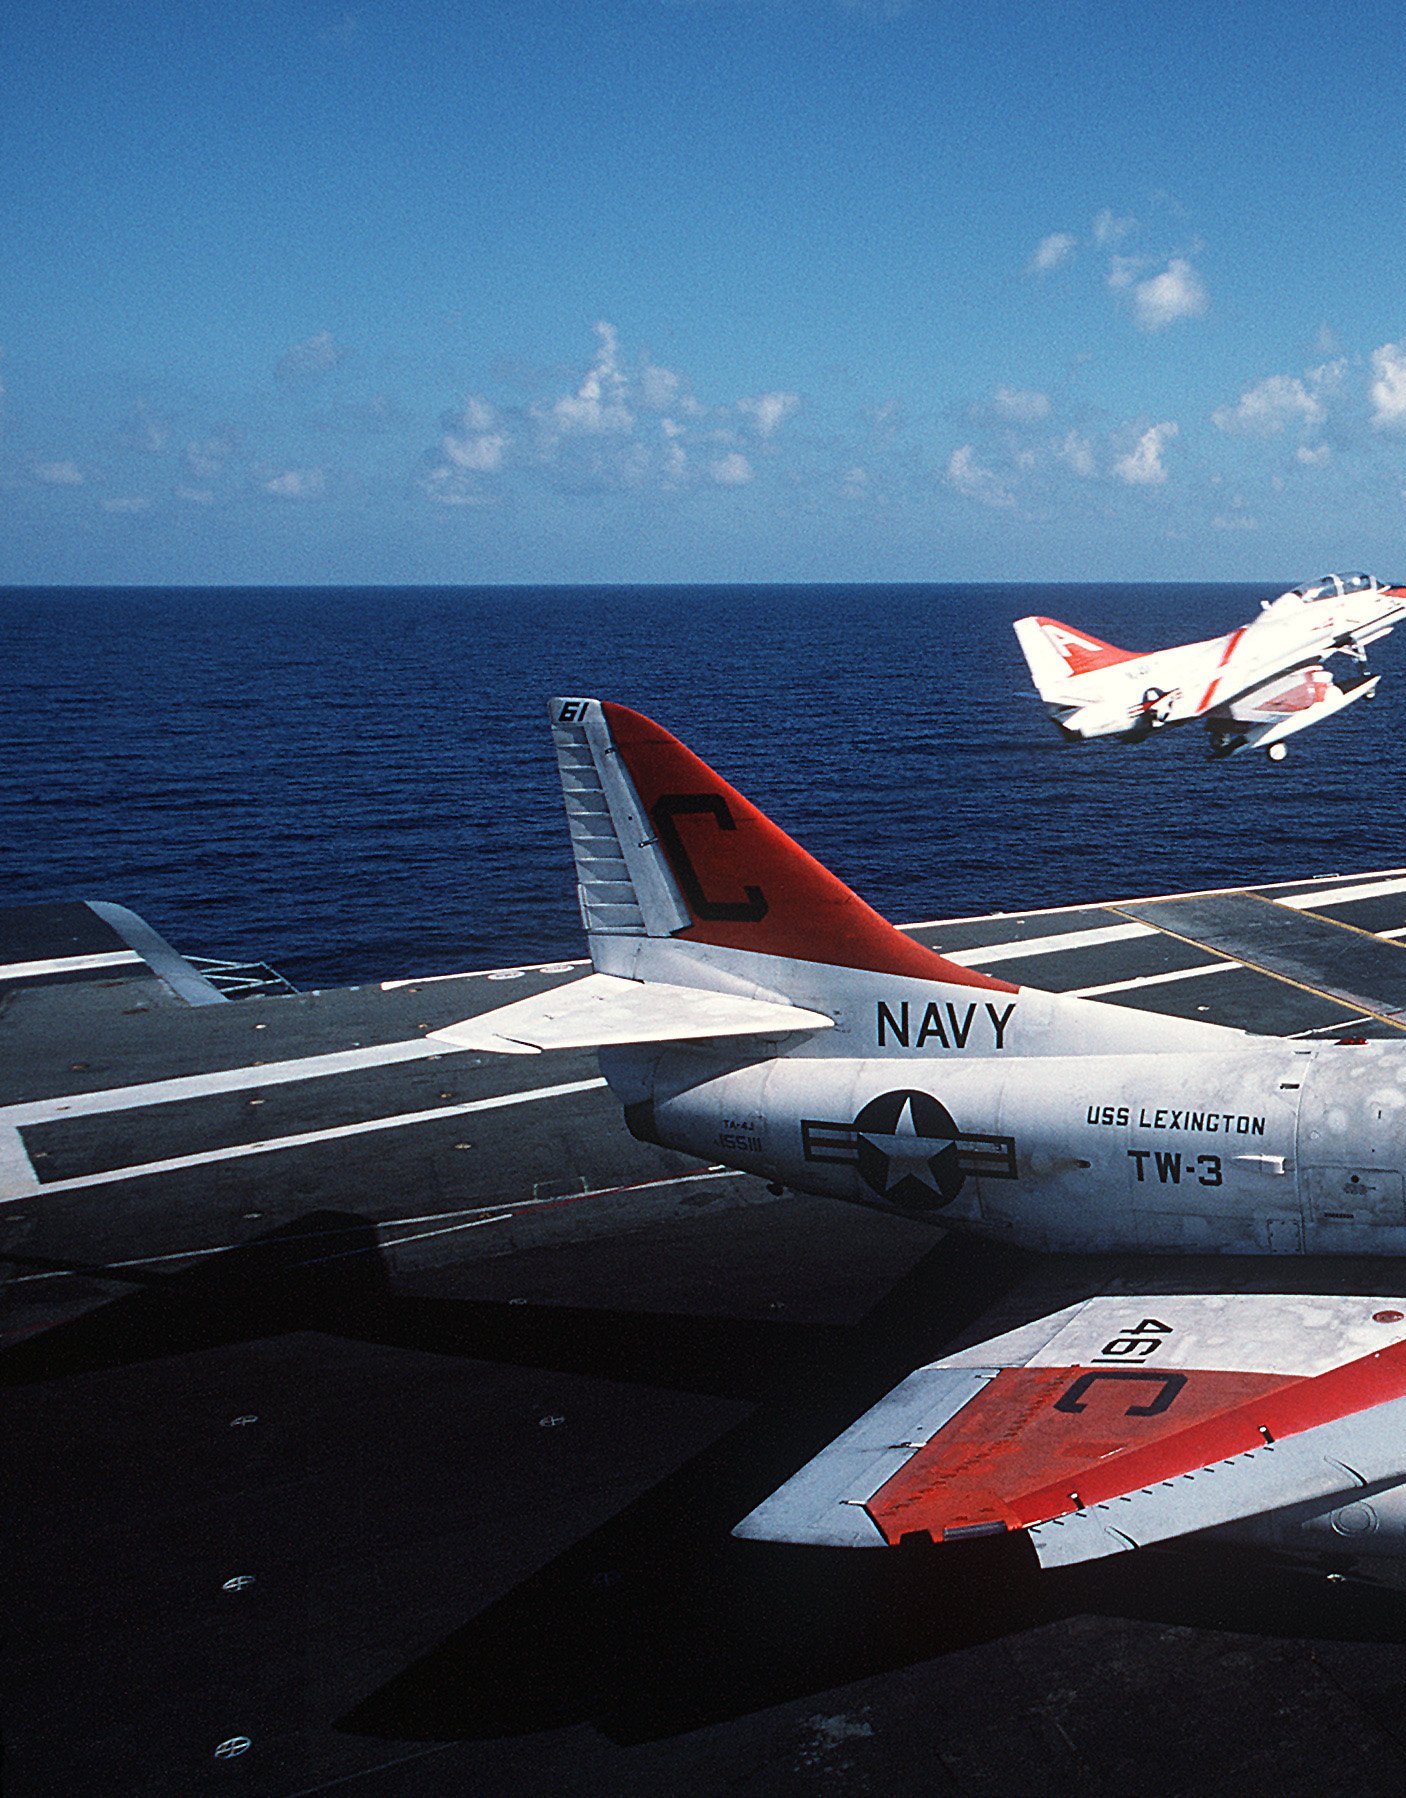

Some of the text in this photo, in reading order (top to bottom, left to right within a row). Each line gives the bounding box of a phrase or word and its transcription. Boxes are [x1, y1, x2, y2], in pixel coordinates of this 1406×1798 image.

[558, 702, 590, 722] 61
[650, 793, 769, 922] C
[877, 1001, 1017, 1049] NAVY
[1087, 1105, 1266, 1136] USS LEXINGTON
[1127, 1150, 1223, 1187] TW-3
[1091, 1318, 1174, 1364] 461
[1053, 1370, 1189, 1417] C
